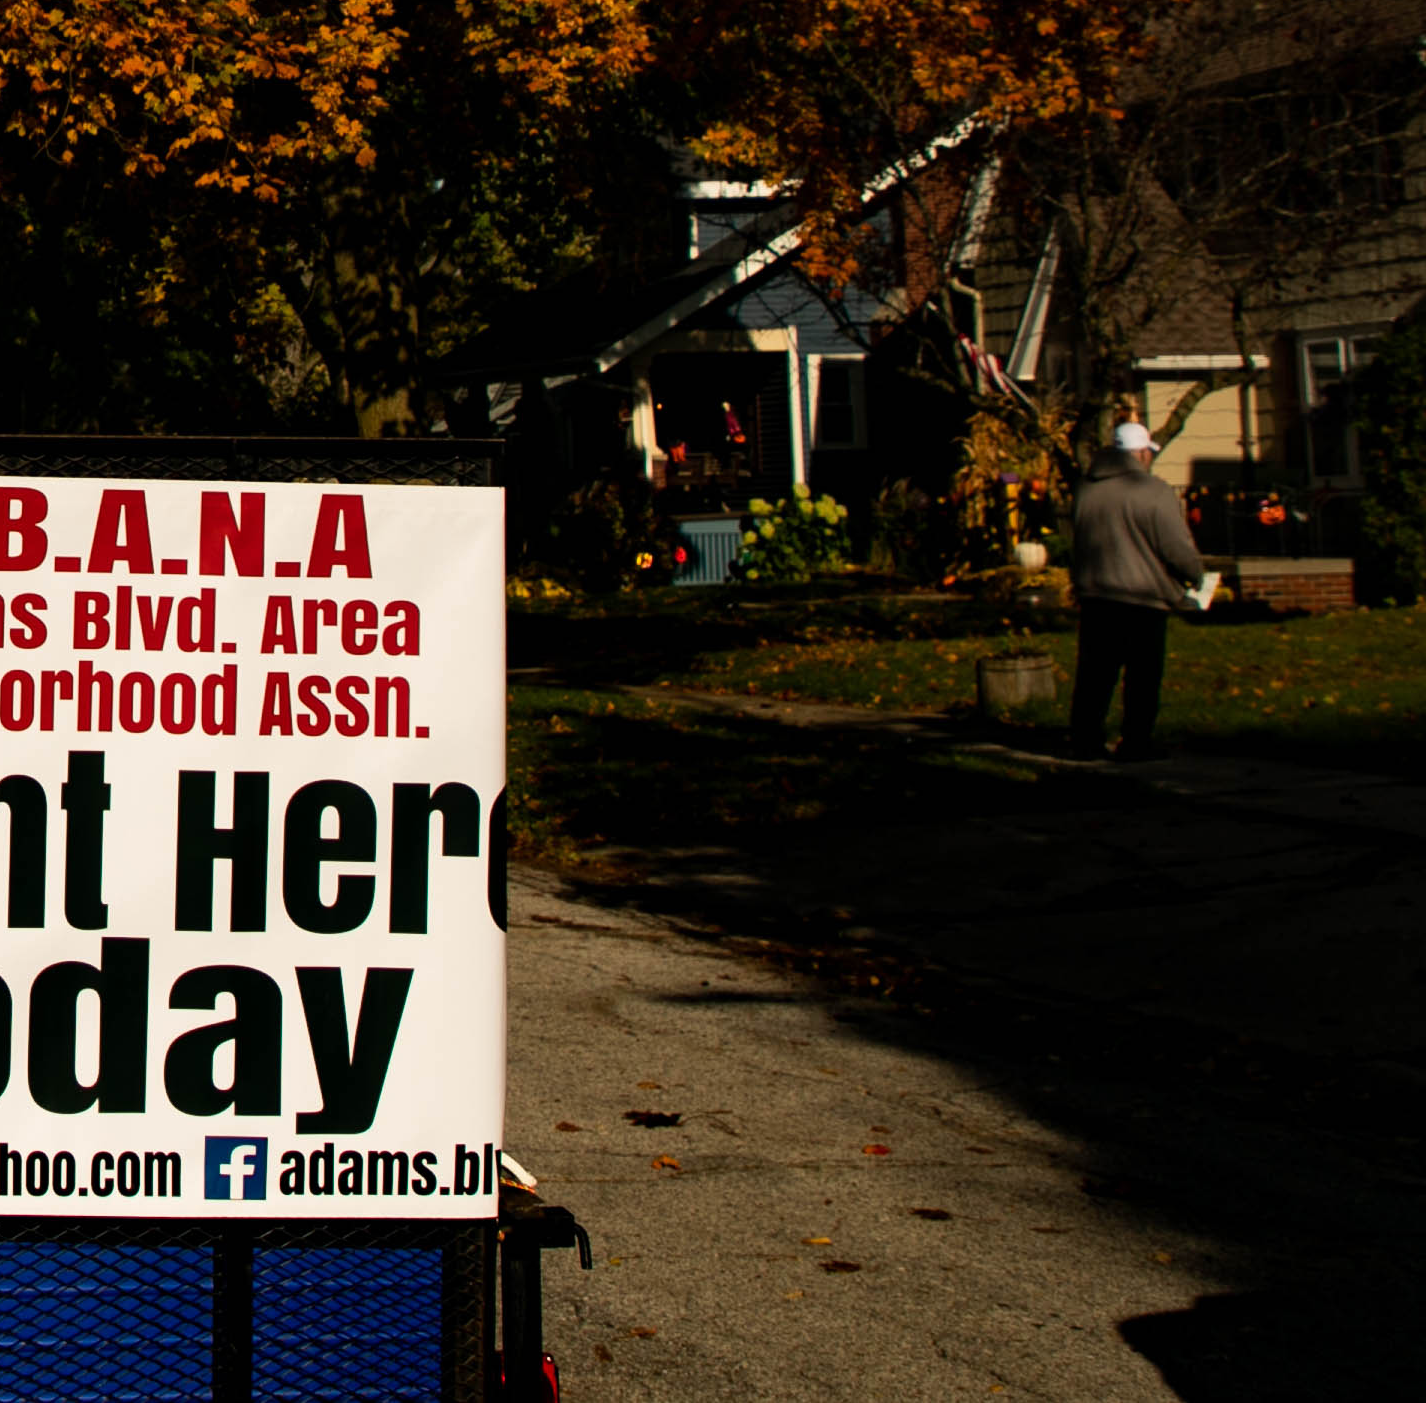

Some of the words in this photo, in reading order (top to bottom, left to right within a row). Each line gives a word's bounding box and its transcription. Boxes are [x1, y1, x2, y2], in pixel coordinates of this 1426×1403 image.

[73, 586, 237, 654] Blvd.
[260, 596, 421, 657] Area
[259, 672, 431, 739] Assn.
